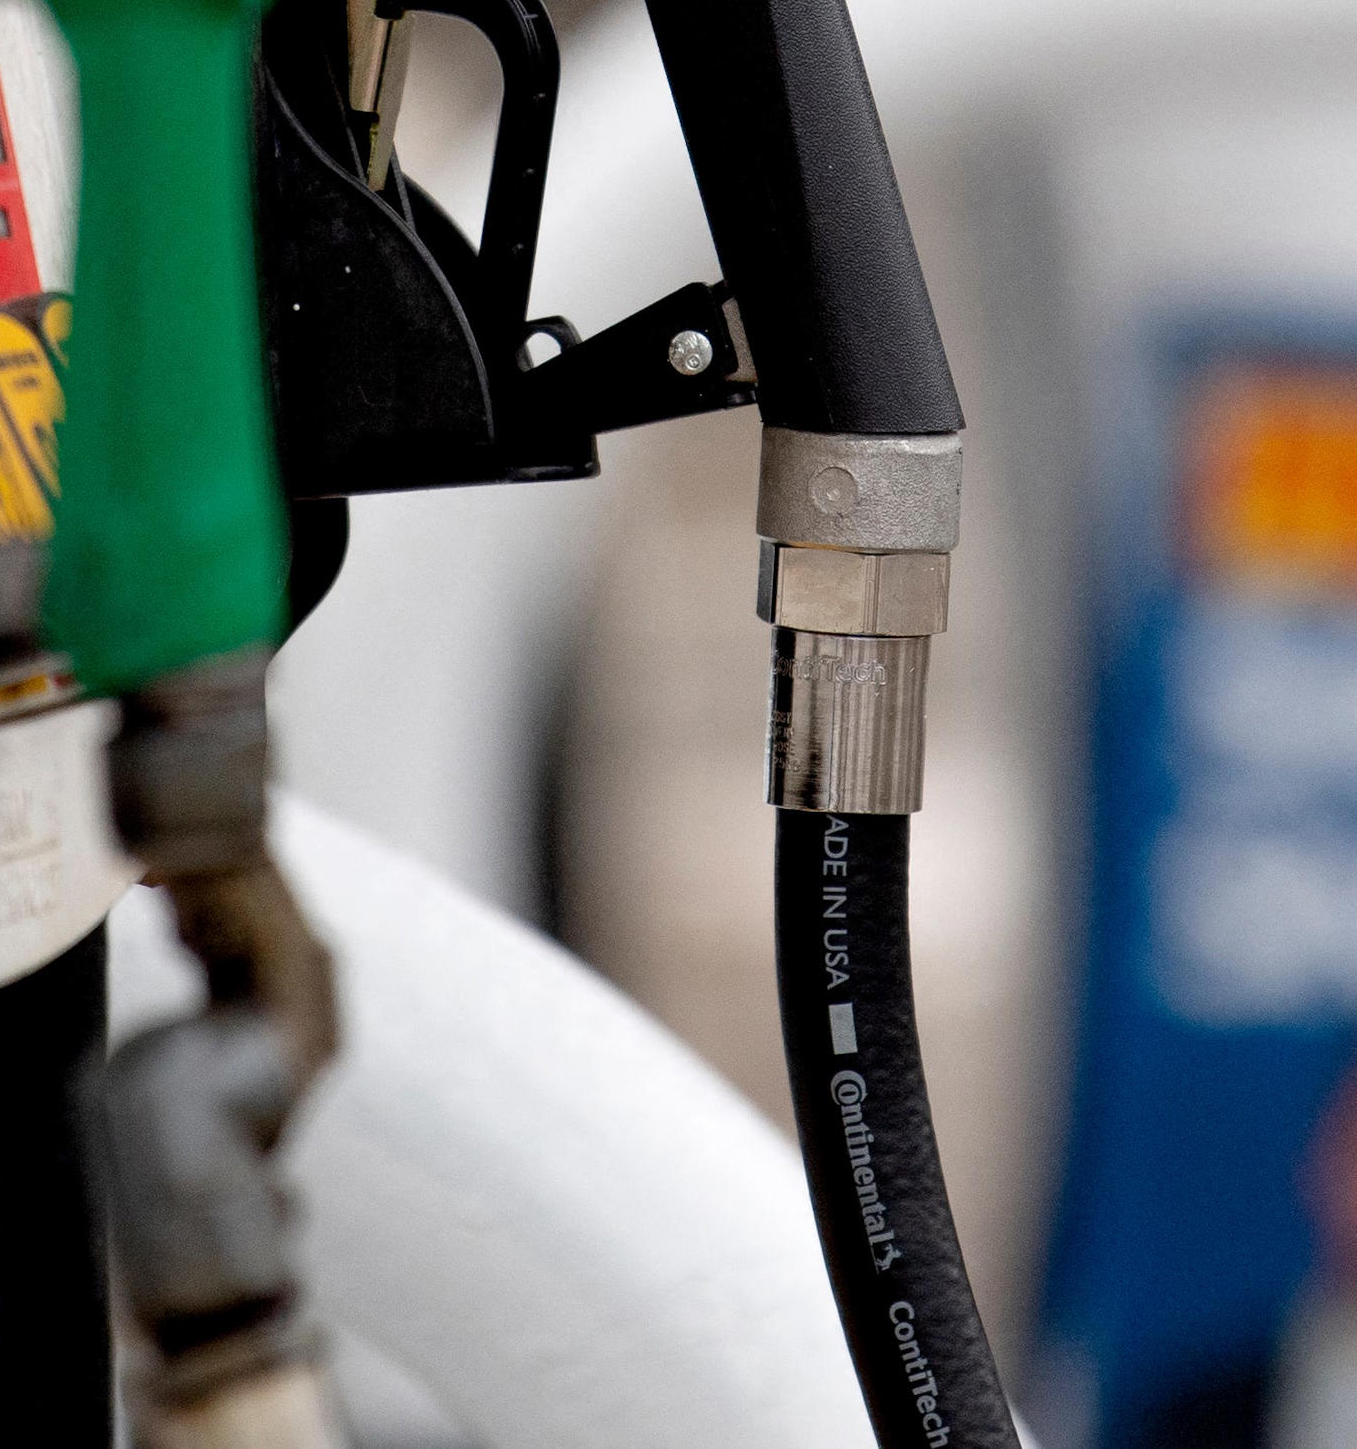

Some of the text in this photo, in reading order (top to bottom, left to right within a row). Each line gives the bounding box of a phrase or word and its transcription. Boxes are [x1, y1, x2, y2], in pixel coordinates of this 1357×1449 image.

[822, 813, 850, 991] ADE IN USA
[830, 1069, 951, 1448] Continental ContiTech
